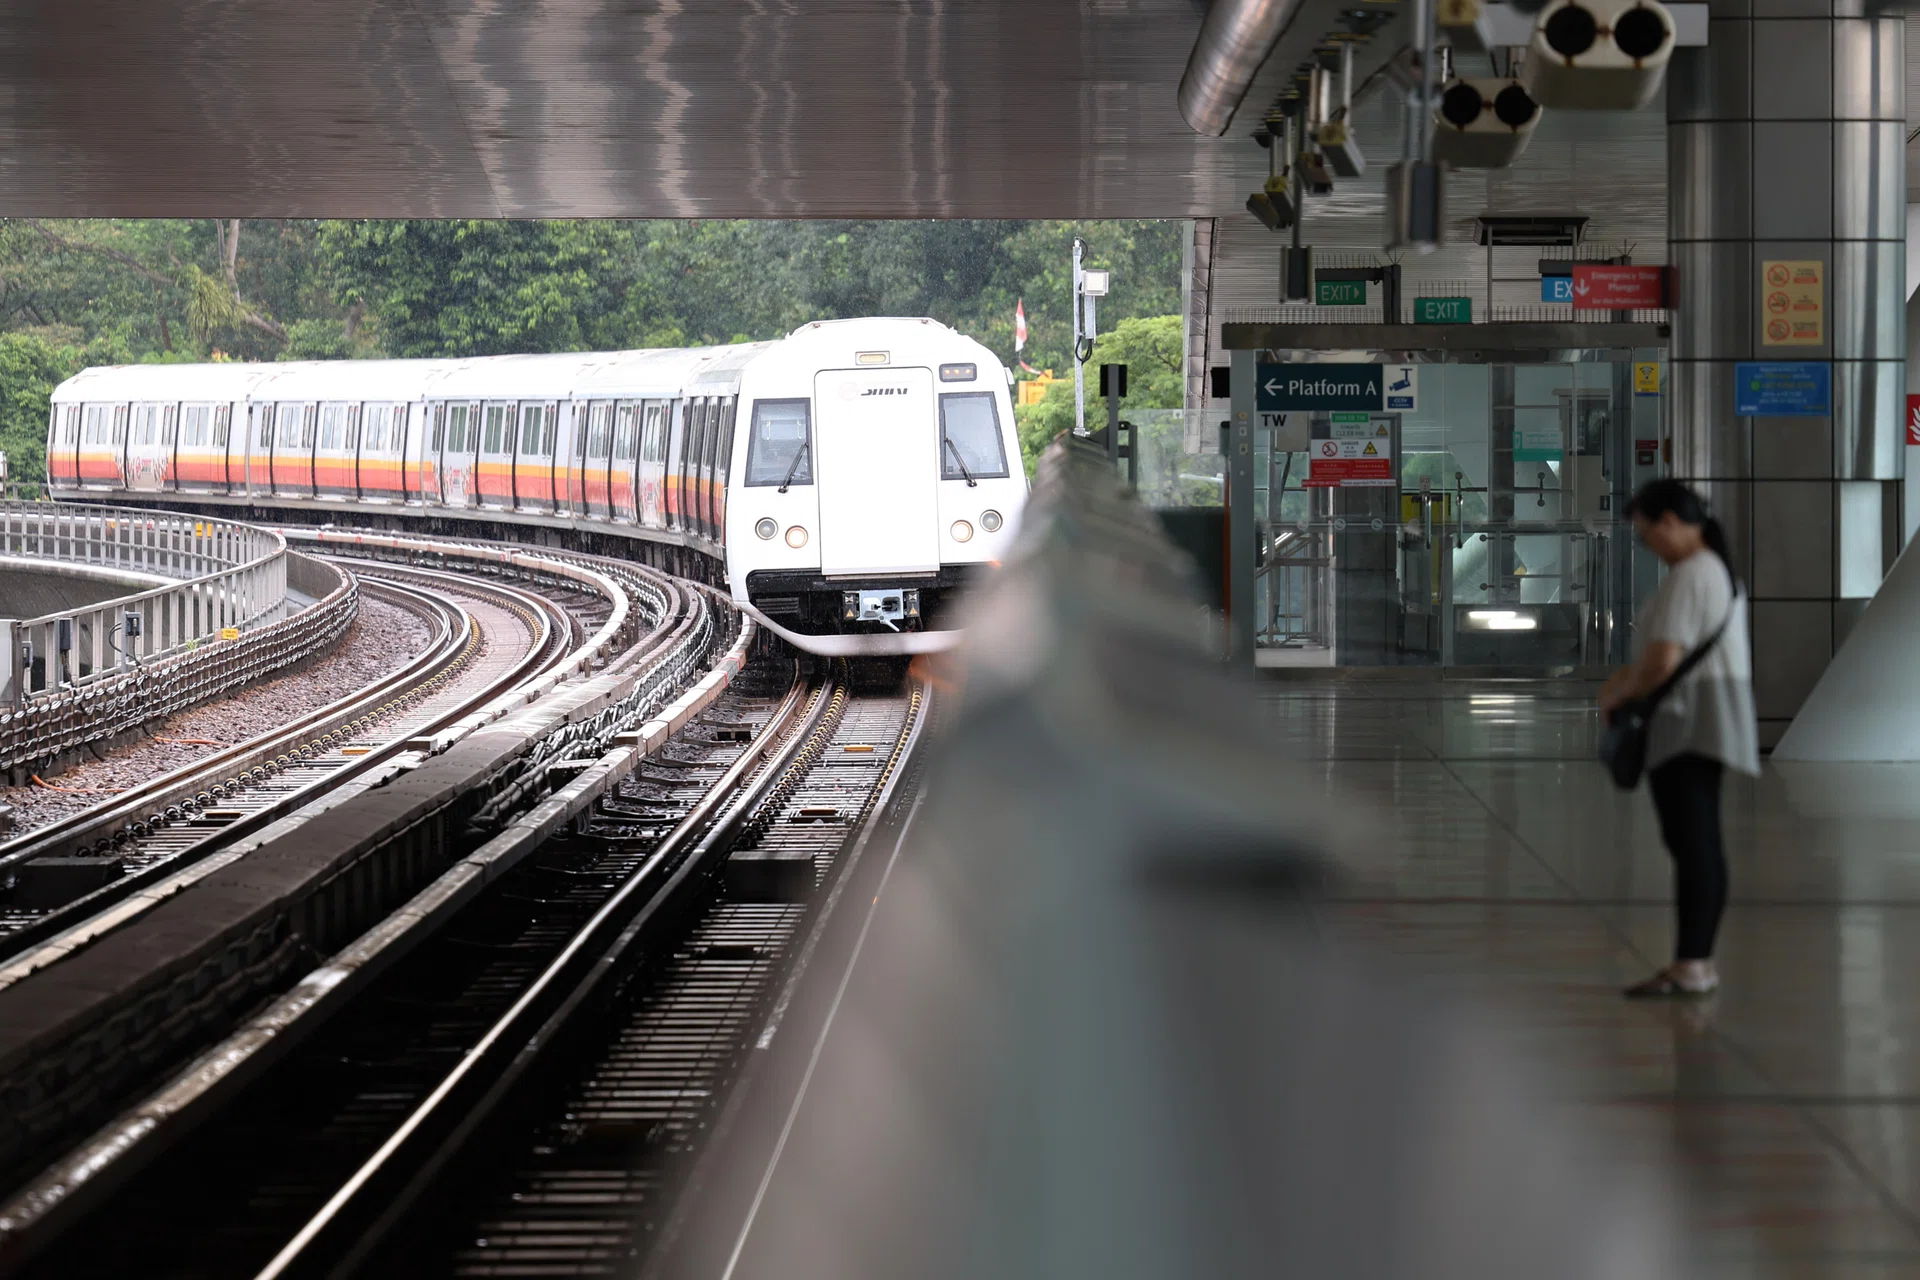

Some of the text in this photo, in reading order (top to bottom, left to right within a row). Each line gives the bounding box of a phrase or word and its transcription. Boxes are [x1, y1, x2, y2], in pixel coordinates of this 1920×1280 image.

[1321, 285, 1352, 301] EXIT
[1554, 281, 1574, 298] EX
[1425, 302, 1460, 319] EXIT
[1289, 379, 1377, 396] Platform A
[1261, 414, 1287, 427] TW
